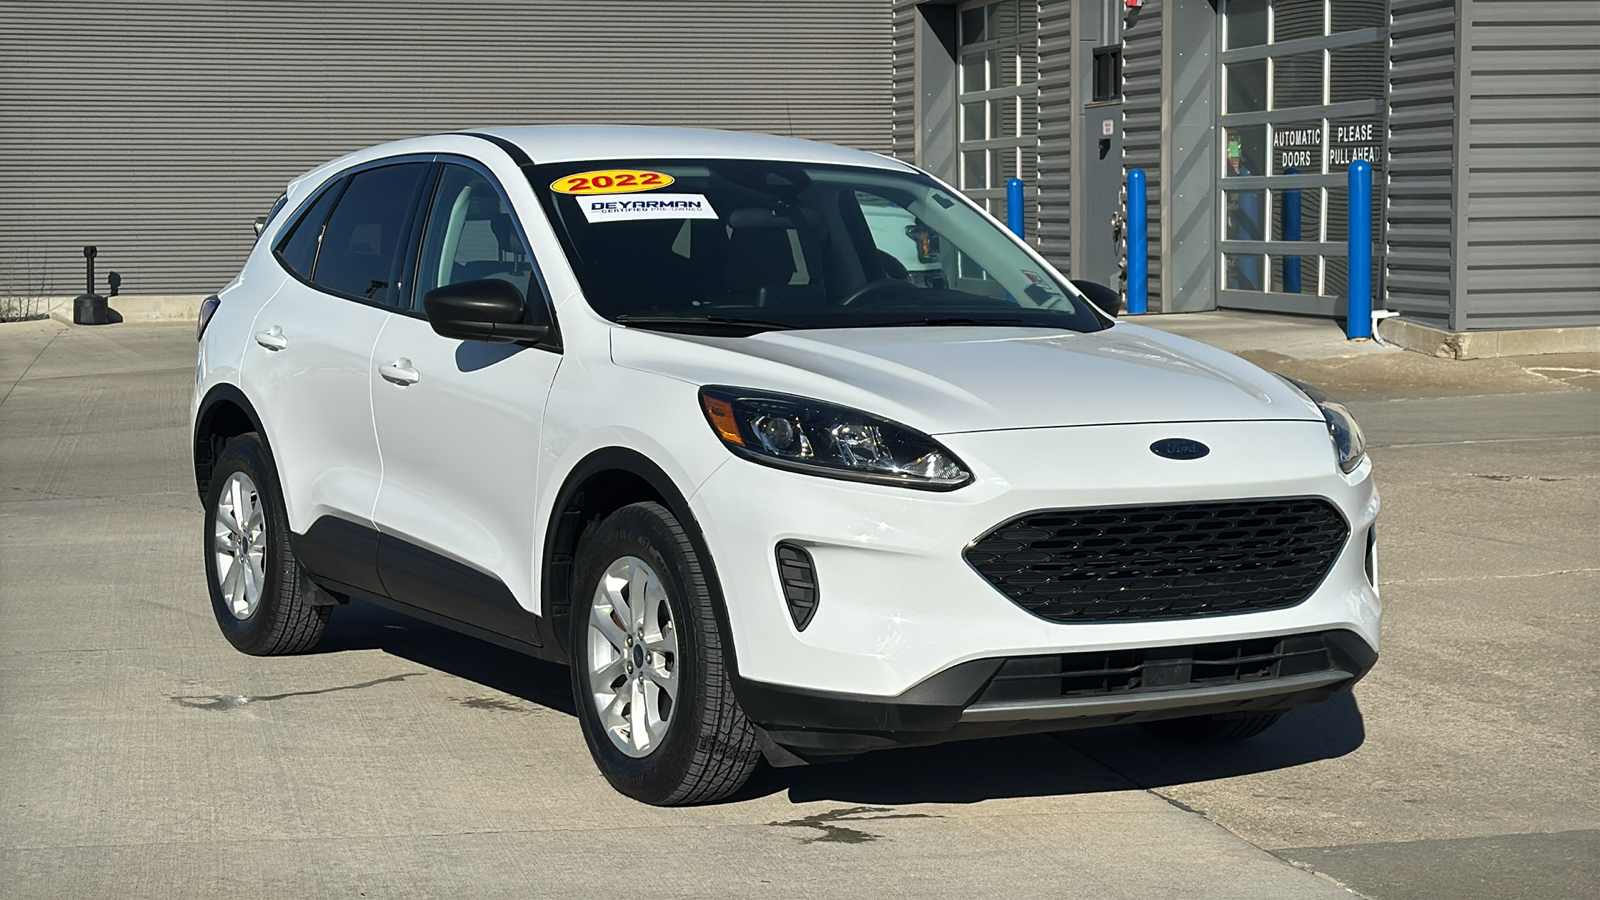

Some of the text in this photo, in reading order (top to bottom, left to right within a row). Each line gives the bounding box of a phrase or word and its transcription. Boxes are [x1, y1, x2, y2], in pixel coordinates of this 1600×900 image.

[1274, 129, 1321, 147] AUTOMATIC
[1337, 124, 1373, 142] PLEASE
[1282, 151, 1311, 167] DOORS
[1330, 147, 1380, 164] PULL AHEAD
[567, 173, 662, 191] 2022
[591, 201, 701, 210] DEYARMAN
[1166, 440, 1197, 454] Ford
